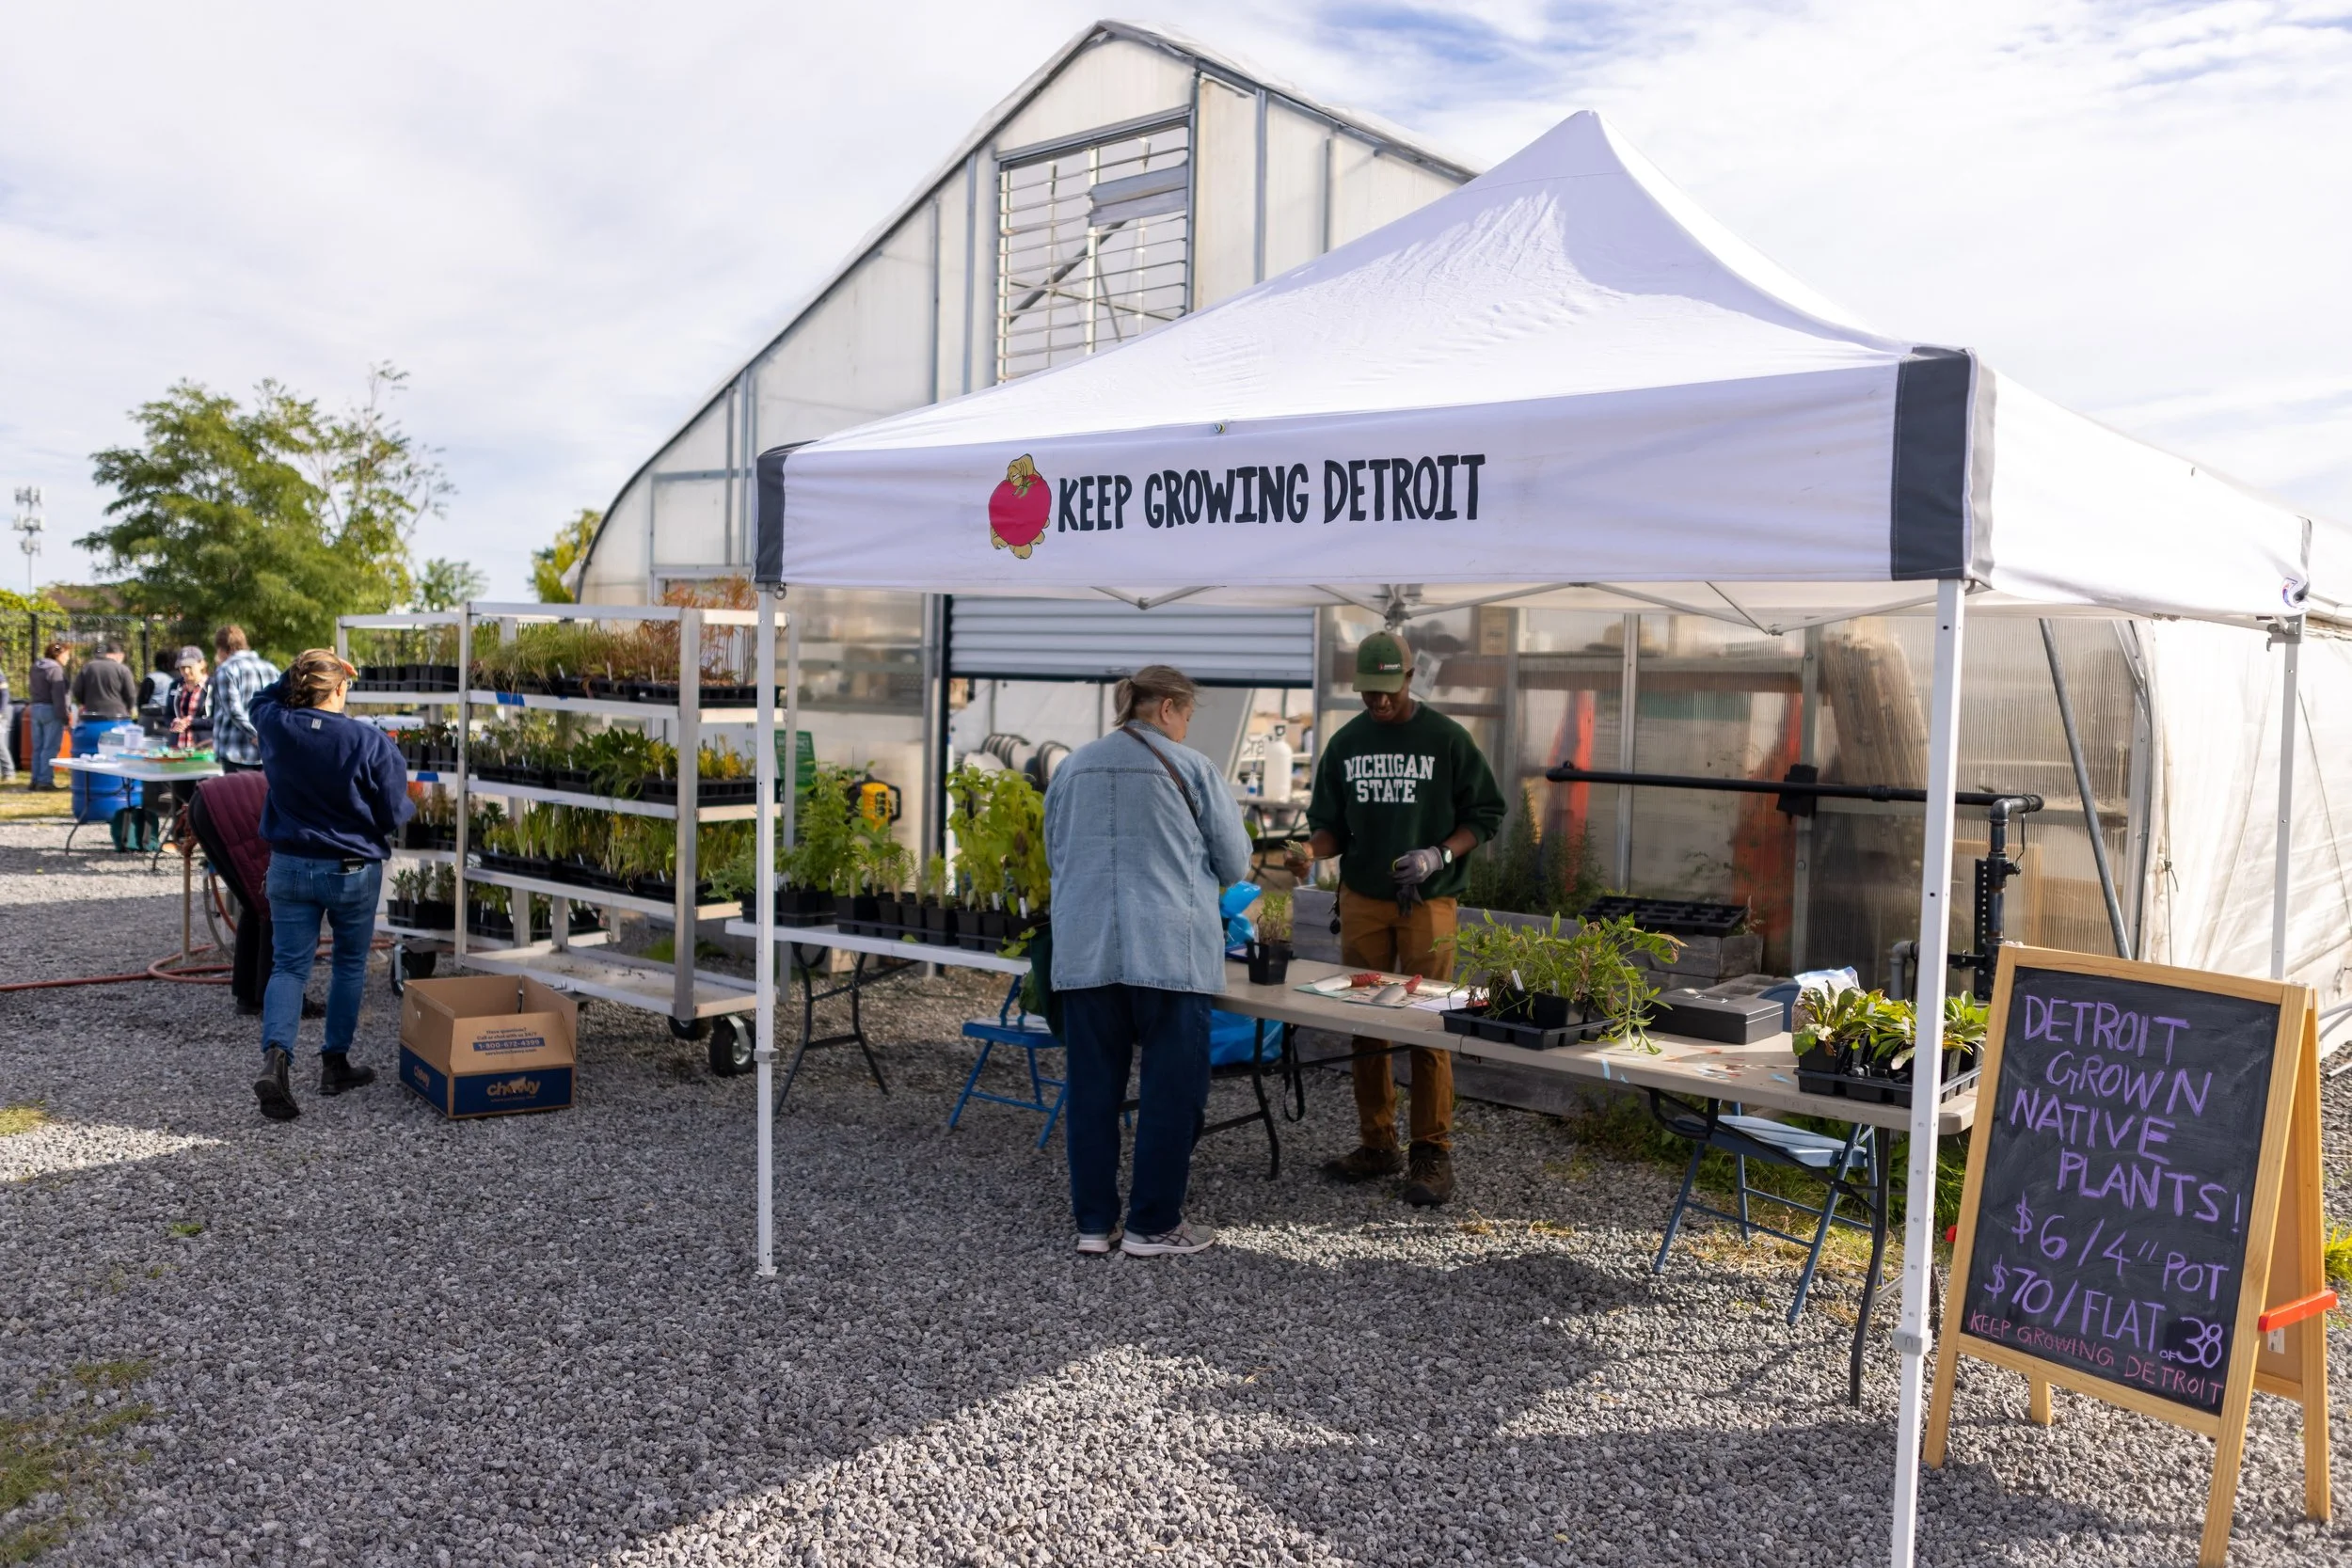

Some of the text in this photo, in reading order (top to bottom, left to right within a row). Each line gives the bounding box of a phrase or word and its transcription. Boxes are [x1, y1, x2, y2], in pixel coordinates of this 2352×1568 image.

[1057, 454, 1486, 532] KEEP GROWING DETROIT
[1343, 753, 1436, 783] MICHIGAN
[1356, 779, 1416, 803] STATE
[479, 1039, 540, 1050] 1-800-672-4399
[2025, 994, 2190, 1066] DETROIT
[2045, 1050, 2213, 1117] GROWN
[2010, 1087, 2176, 1164] NATIVE
[2057, 1147, 2240, 1233] PLANTS!
[2162, 1251, 2230, 1301] POT
[1970, 1308, 2224, 1404] KEEP GROWING DETROIT
[2177, 1316, 2223, 1369] 38
